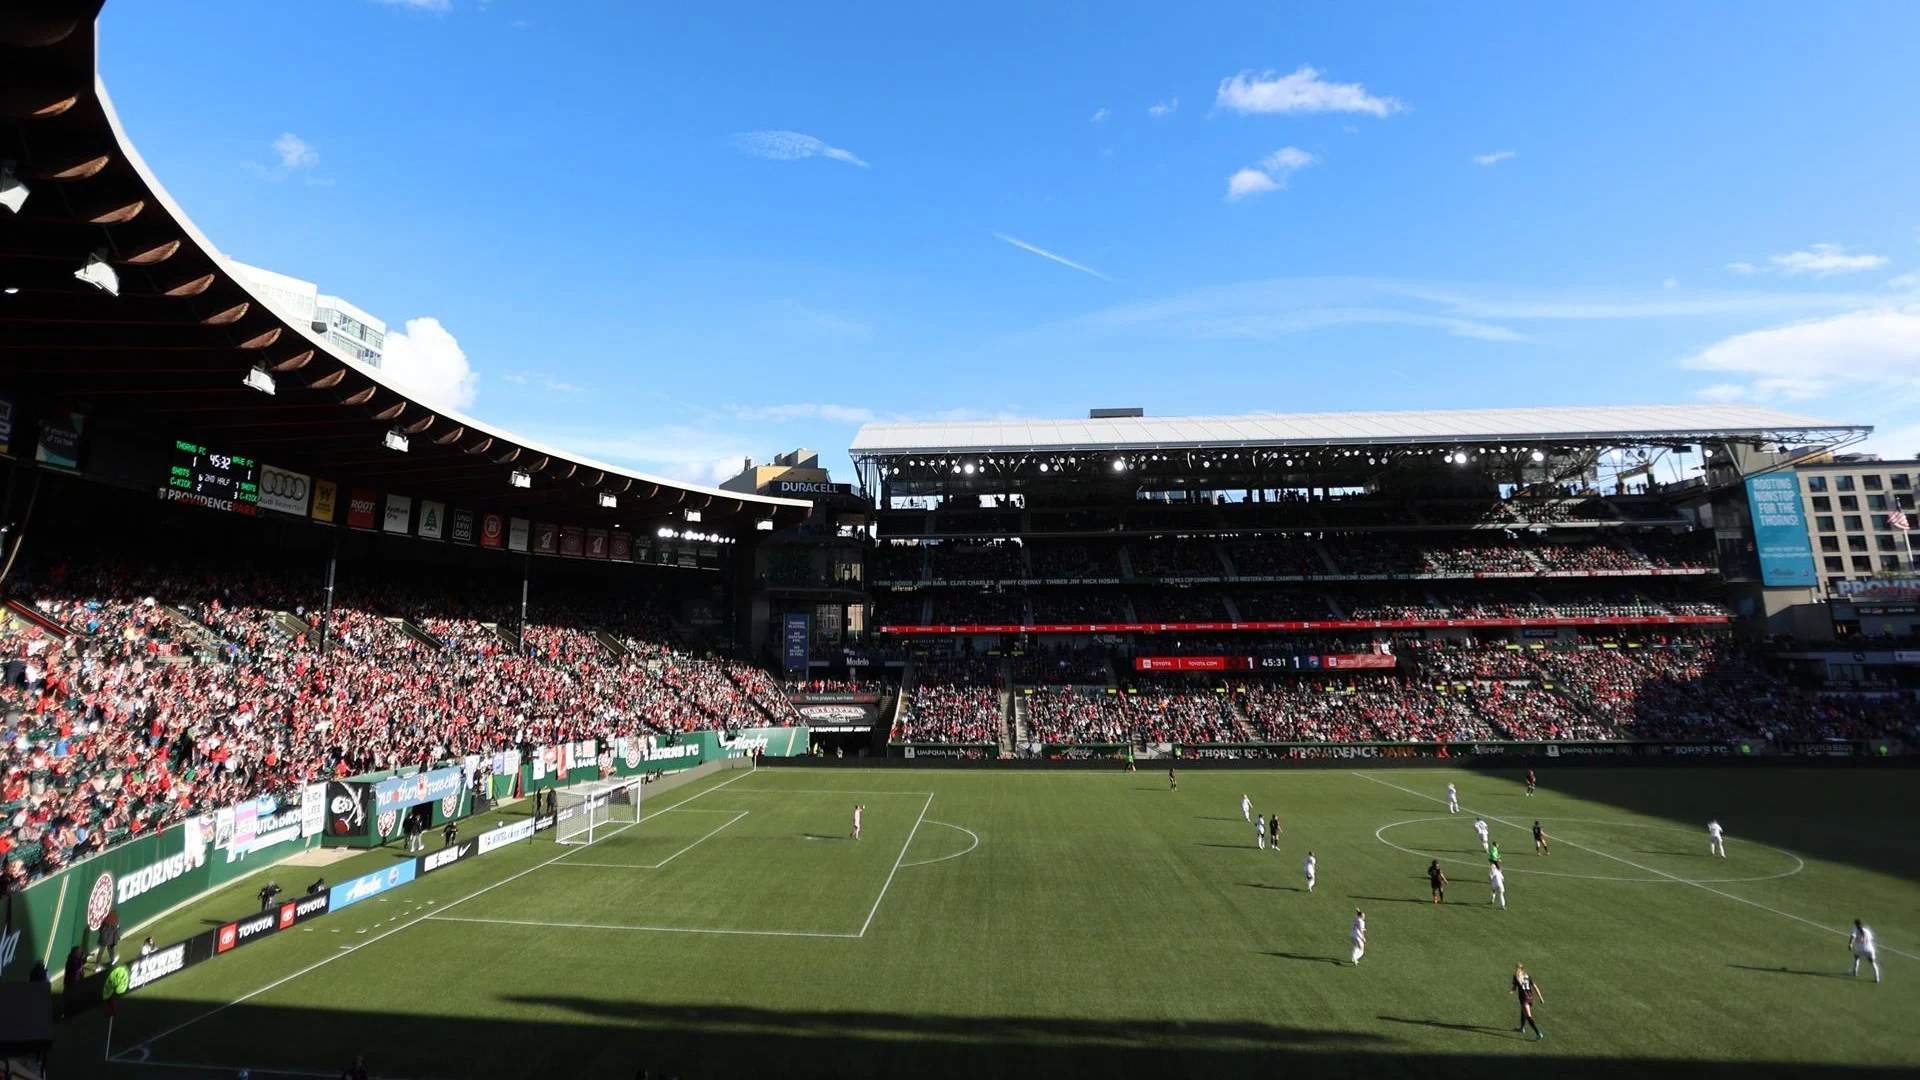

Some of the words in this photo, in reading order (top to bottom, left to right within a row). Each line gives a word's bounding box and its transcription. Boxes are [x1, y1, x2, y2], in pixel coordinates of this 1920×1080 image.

[198, 447, 206, 455] FC
[193, 456, 197, 467] 1
[210, 454, 230, 470] 45:32
[171, 466, 190, 477] SHOTS
[247, 470, 251, 480] 1
[217, 477, 230, 486] HALF
[1752, 479, 1792, 489] ROOTING
[781, 482, 839, 493] DURACELL
[1753, 491, 1795, 502] NONSTOP
[168, 489, 232, 511] PROVIDENCE
[232, 502, 256, 516] PARK
[351, 500, 376, 510] ROOT
[1758, 502, 1776, 513] FOR
[1777, 502, 1796, 513] THE
[1248, 657, 1253, 669] 1
[1262, 659, 1286, 667] 45:31
[1294, 656, 1299, 668] 1
[686, 744, 699, 756] FC
[725, 734, 768, 755] Alaska
[1664, 746, 1710, 754] ORNS
[1382, 746, 1416, 758] PARK
[578, 757, 597, 768] BANK
[256, 816, 278, 835] UTCH
[117, 852, 184, 904] THORNS
[296, 896, 326, 917] TOYOTA
[238, 914, 274, 939] TOYOTA
[130, 963, 139, 980] 2
[140, 944, 185, 975] TOWNS
